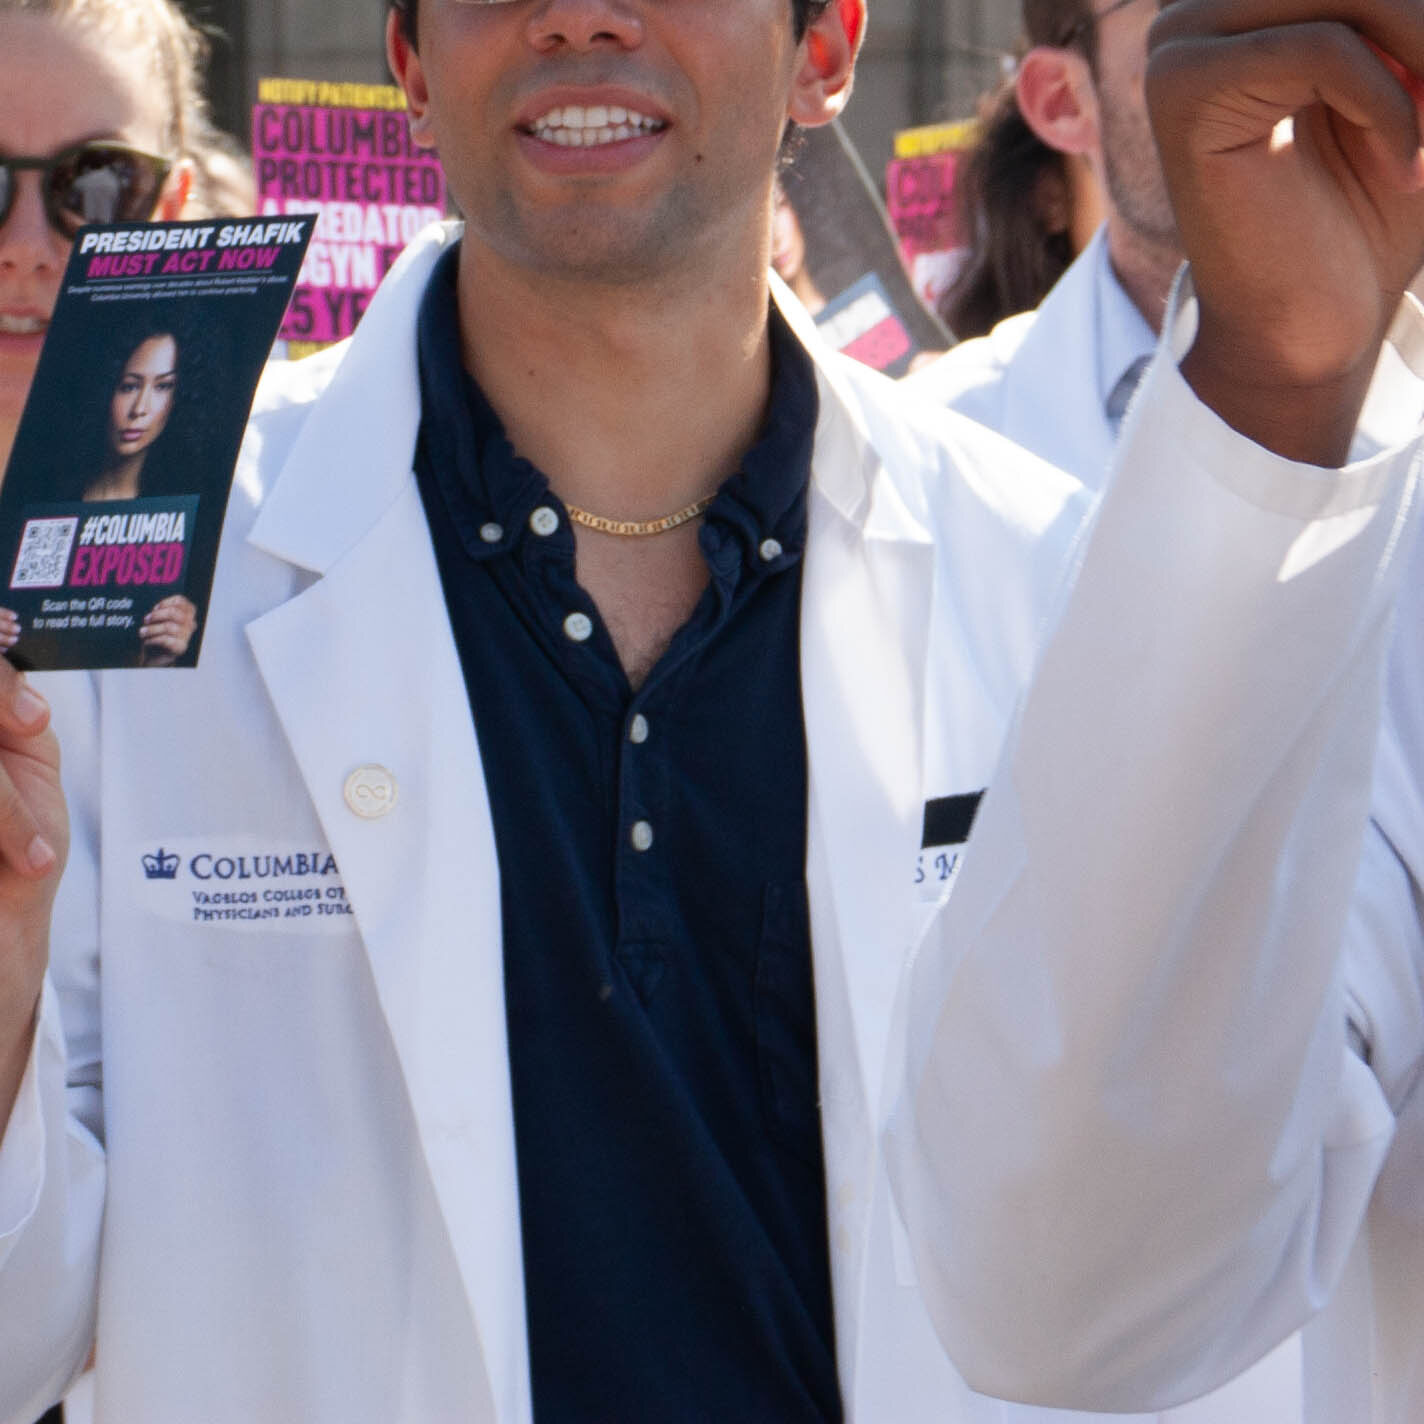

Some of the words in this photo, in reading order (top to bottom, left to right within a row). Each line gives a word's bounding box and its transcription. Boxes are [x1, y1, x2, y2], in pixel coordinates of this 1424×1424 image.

[258, 107, 438, 158] COLUMBI
[259, 159, 440, 204] PROTECTED
[80, 226, 215, 255] PRESIDENT
[216, 221, 306, 248] SHAFIK
[86, 252, 159, 278] MUST
[161, 249, 216, 274] ACT
[217, 246, 281, 271] NOW
[80, 511, 186, 546] #COLUMBIA
[69, 542, 184, 587] EXPOSED
[41, 598, 66, 613] Scan
[69, 597, 86, 612] the
[106, 596, 134, 611] code
[32, 616, 44, 630] to
[45, 615, 69, 630] read
[71, 614, 87, 628] the
[189, 853, 339, 880] COLUMBIA
[192, 889, 258, 906] VAGELOS
[262, 886, 321, 903] COLLEGE
[193, 906, 281, 922] PHYSICIANS
[284, 904, 313, 918] AND
